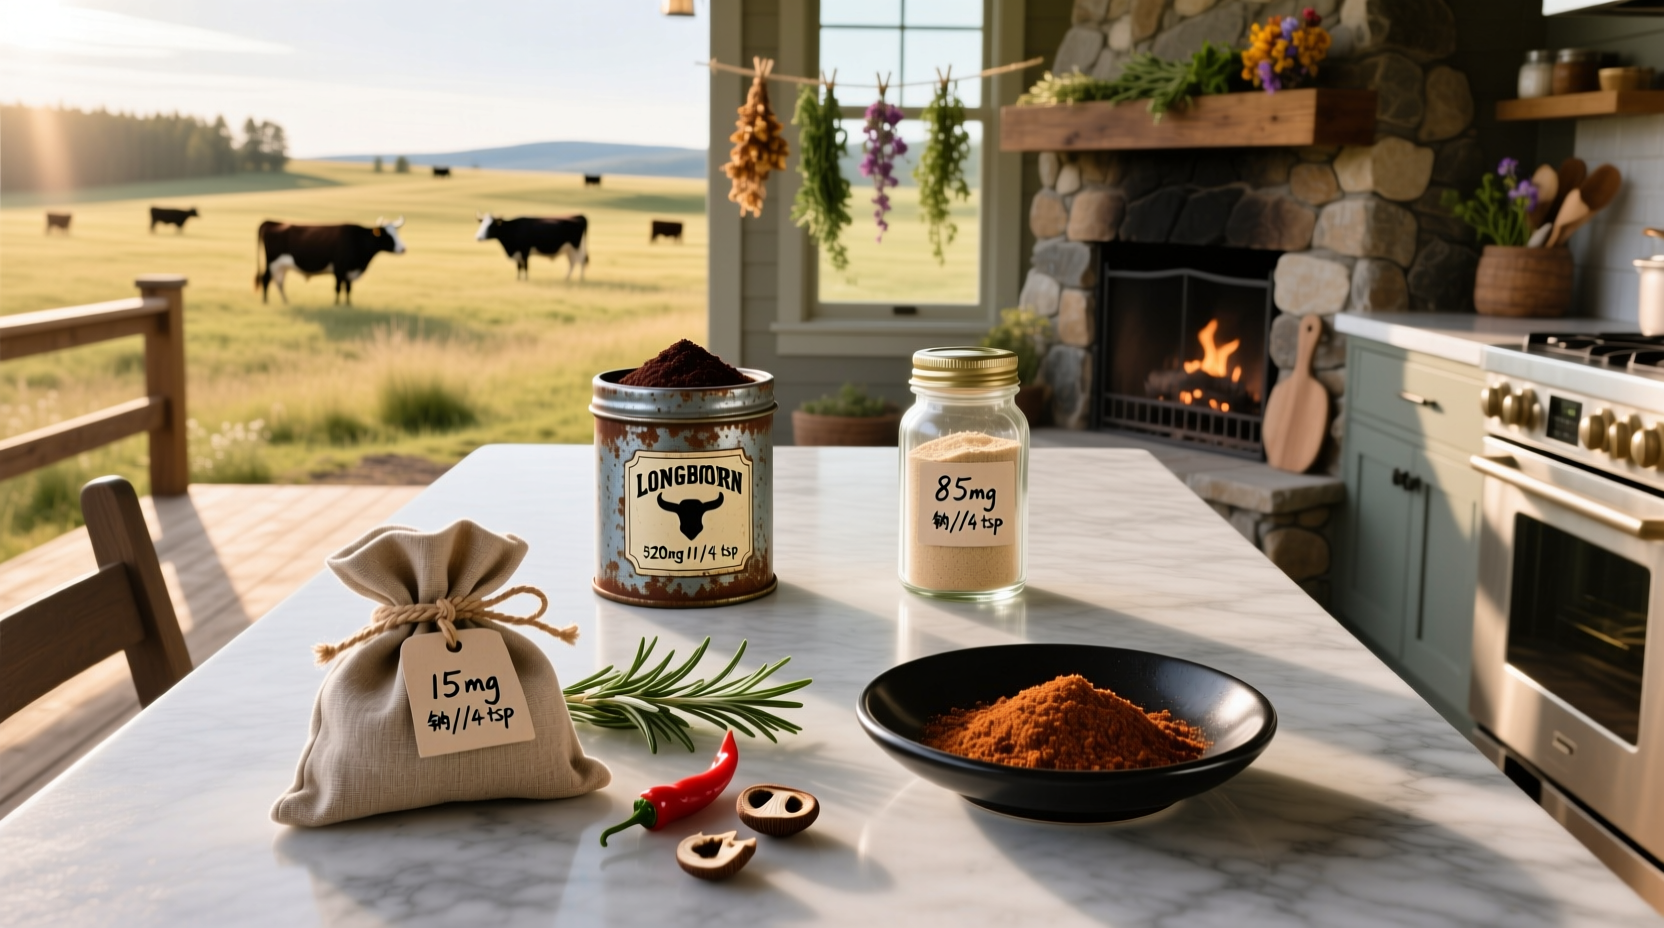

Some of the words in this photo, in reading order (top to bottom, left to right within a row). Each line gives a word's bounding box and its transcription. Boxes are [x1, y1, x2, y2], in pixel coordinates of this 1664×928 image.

[935, 474, 996, 513] 85mg
[980, 514, 1004, 536] tsp
[721, 544, 738, 560] tsp
[432, 669, 500, 706] 15mg
[486, 706, 515, 730] tsp
